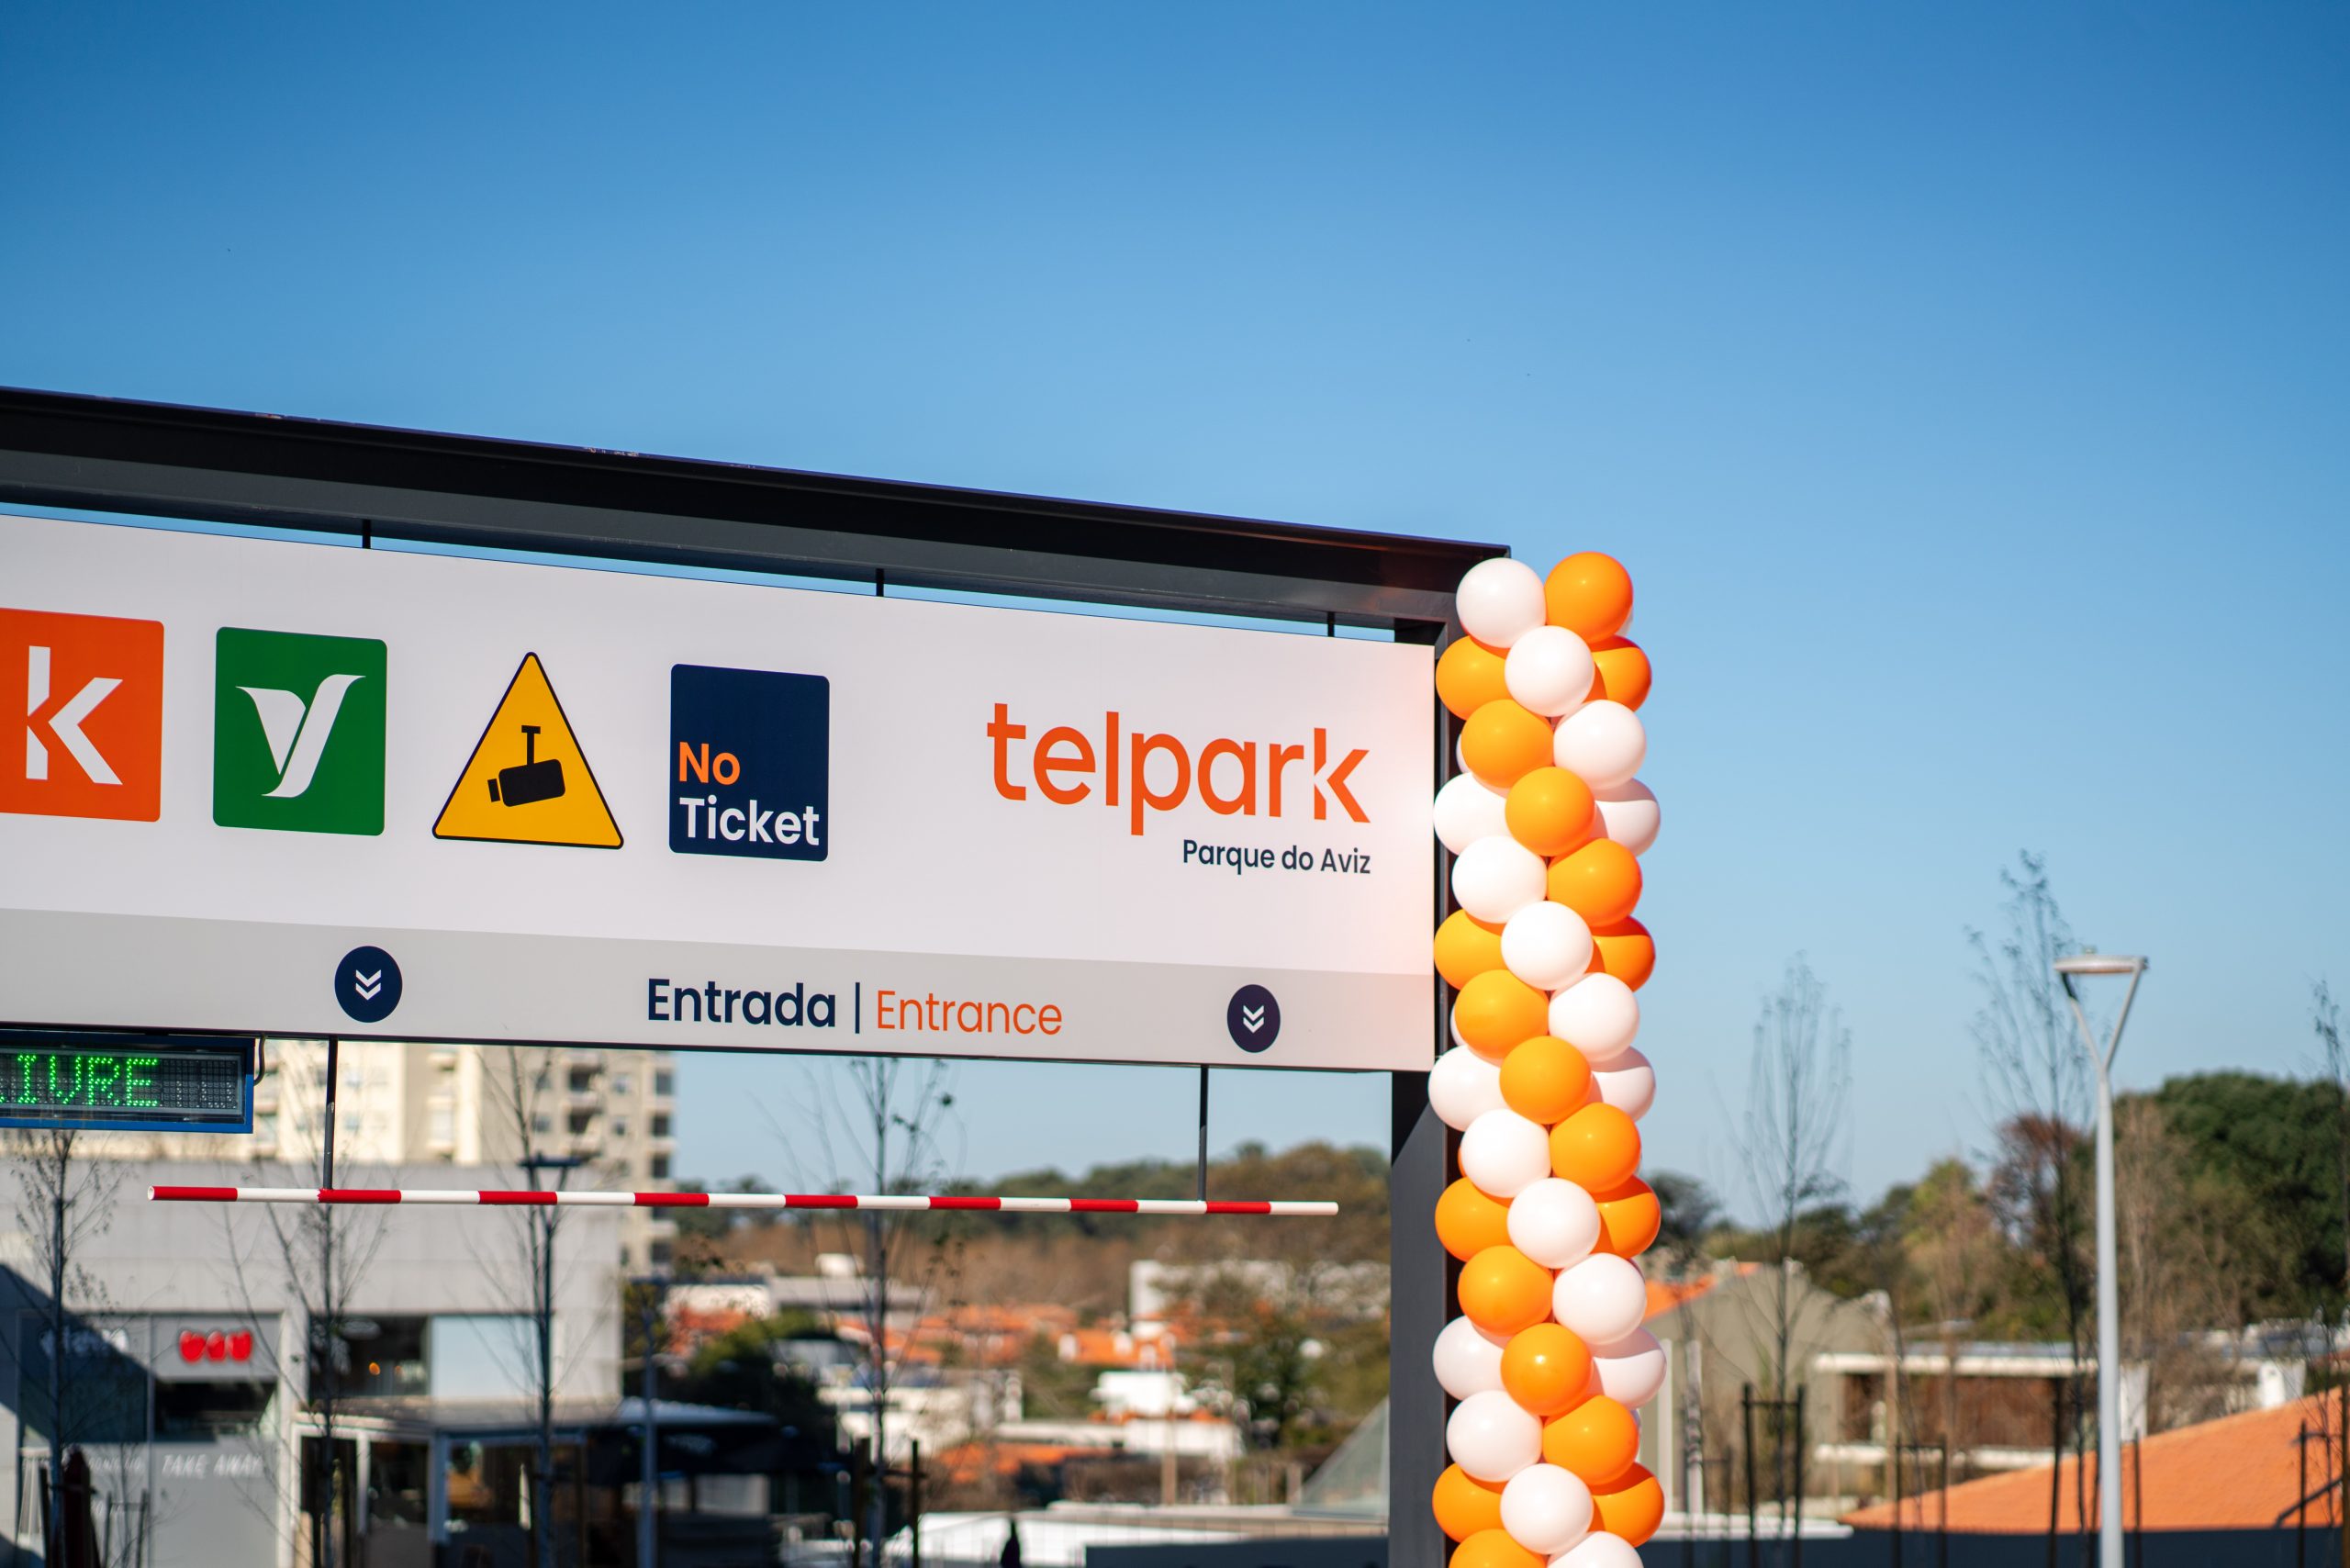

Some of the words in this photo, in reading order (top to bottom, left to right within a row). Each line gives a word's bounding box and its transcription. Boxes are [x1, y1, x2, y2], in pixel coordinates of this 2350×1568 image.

[679, 741, 741, 786] No
[986, 702, 1371, 836] telpark
[680, 794, 820, 846] Ticket
[1182, 839, 1275, 876] Parque
[1281, 845, 1314, 871] do
[1320, 847, 1371, 874] Aviz
[648, 979, 836, 1028] Entrada
[878, 990, 1063, 1036] Entrance
[0, 1055, 159, 1107] IVRE
[162, 1454, 207, 1479] TAKE
[213, 1453, 263, 1477] AWAY
